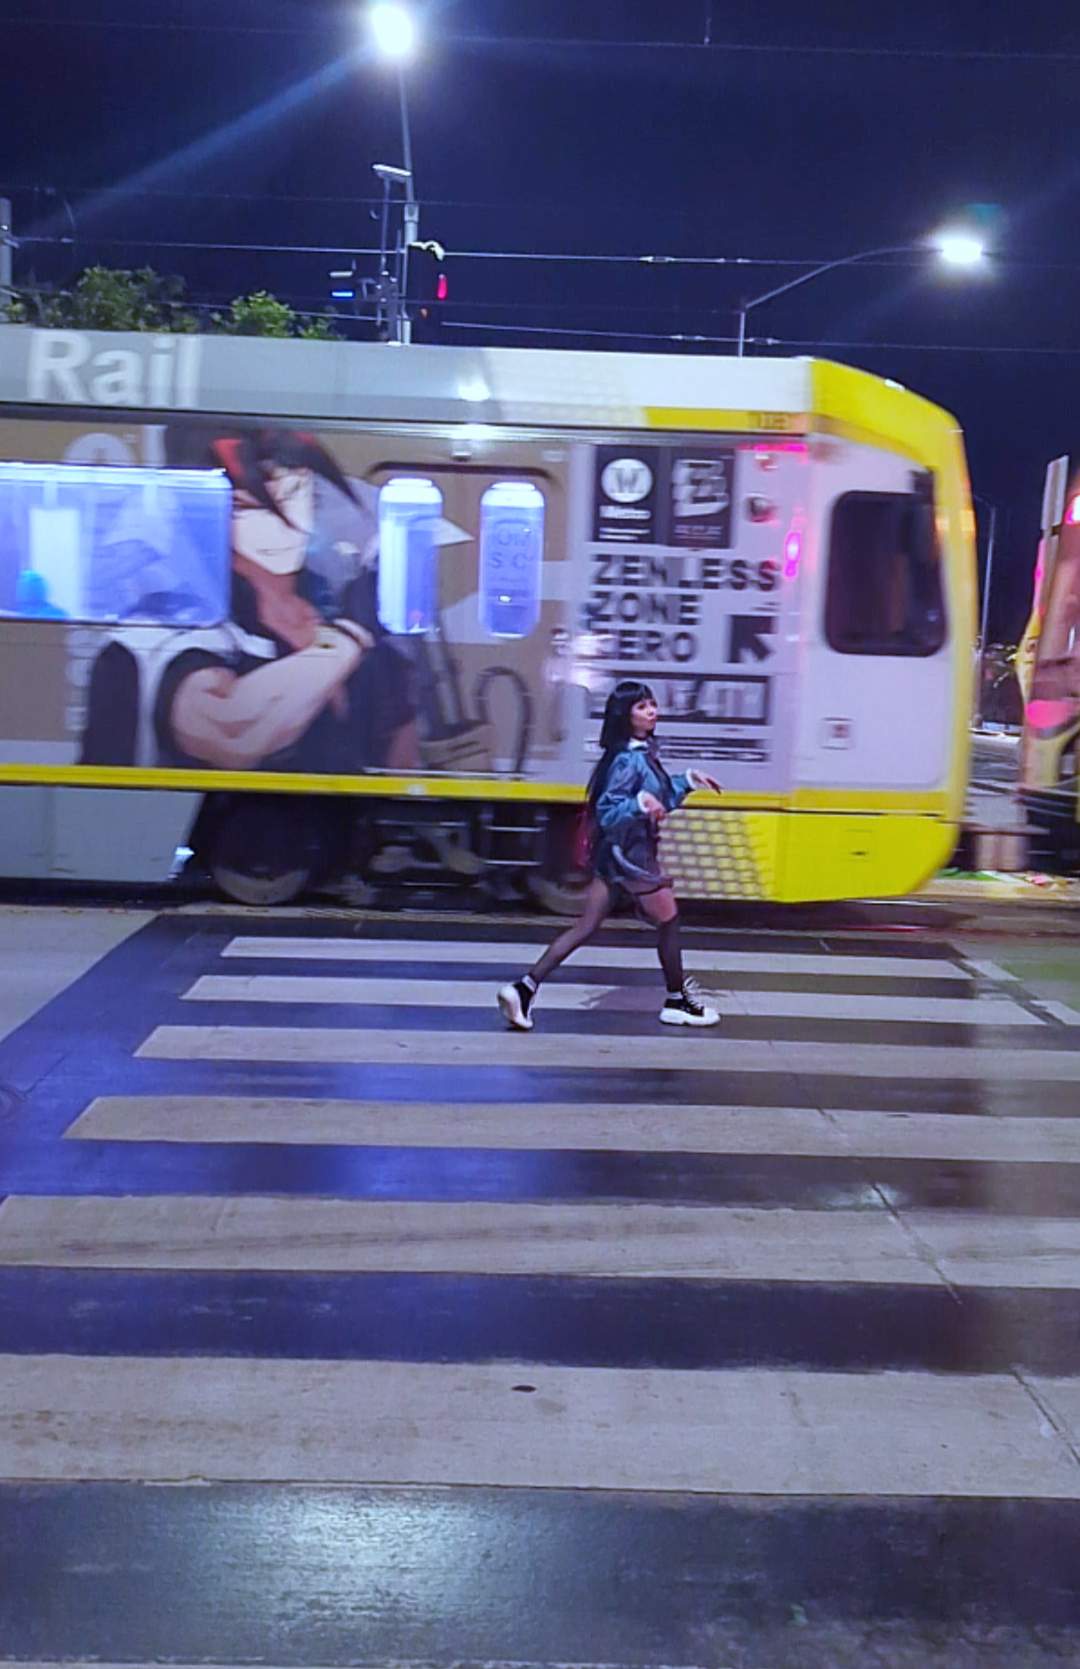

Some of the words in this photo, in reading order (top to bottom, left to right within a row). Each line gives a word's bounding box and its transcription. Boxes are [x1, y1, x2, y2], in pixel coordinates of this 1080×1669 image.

[28, 329, 201, 408] Rail
[592, 554, 779, 592] ZENLESS
[591, 590, 698, 626] ZONE
